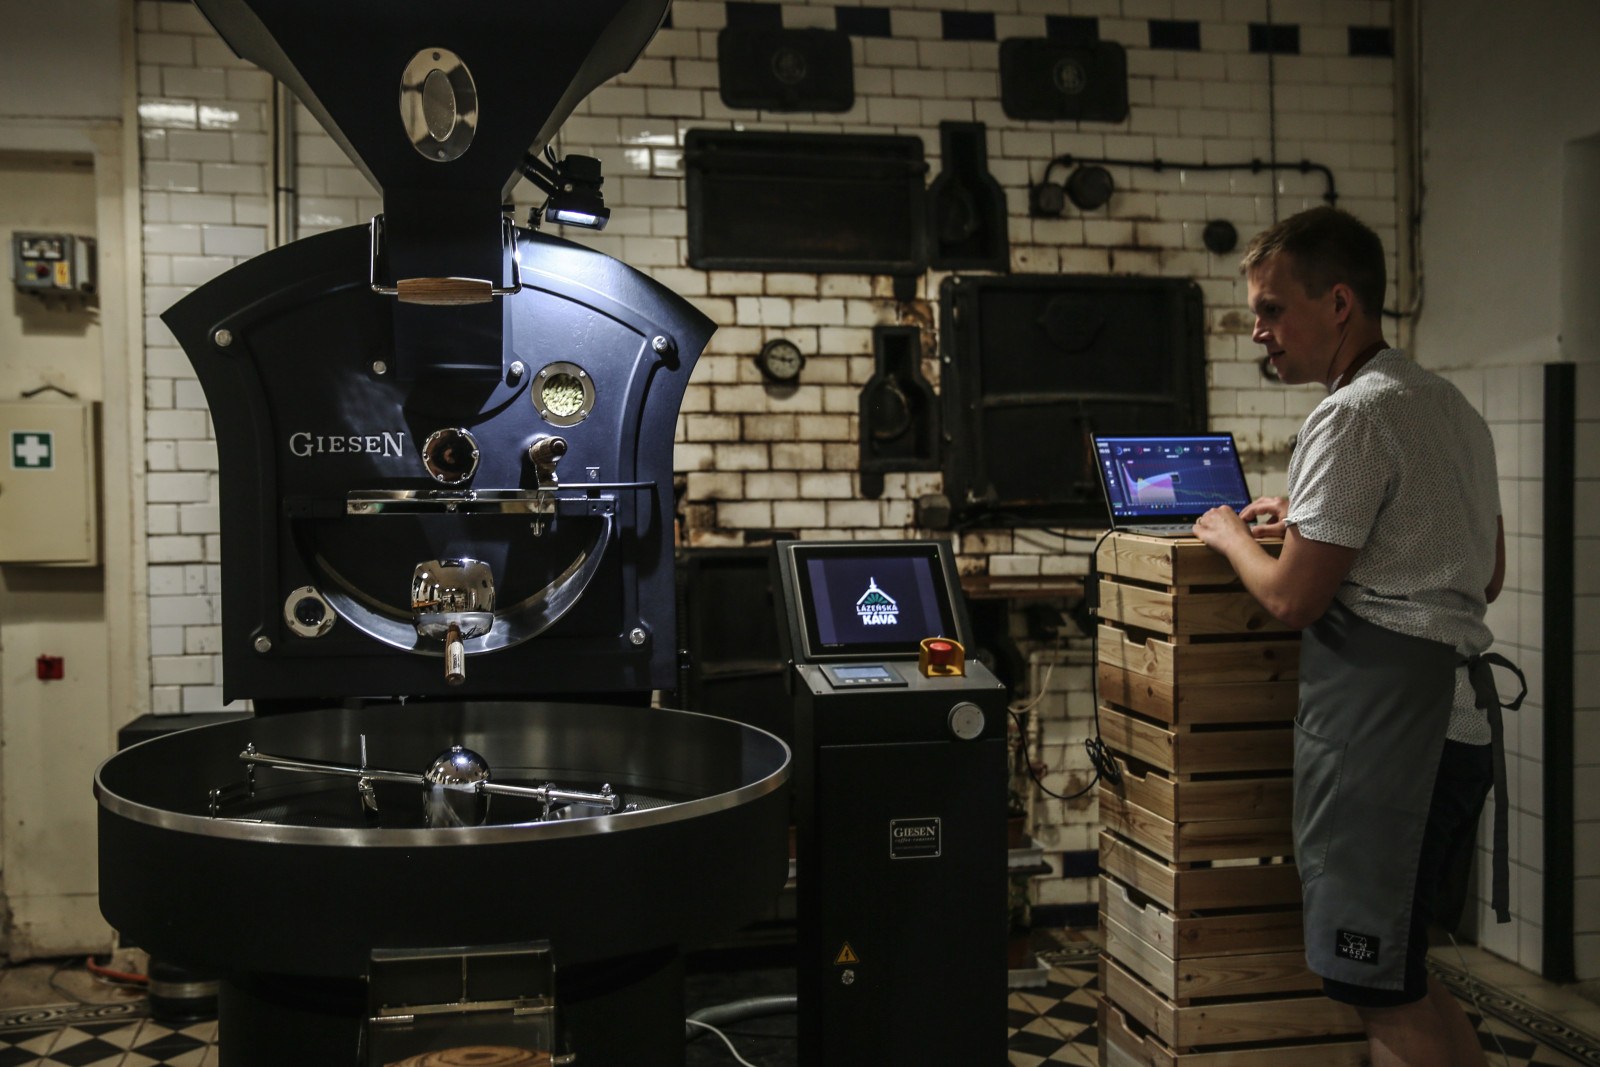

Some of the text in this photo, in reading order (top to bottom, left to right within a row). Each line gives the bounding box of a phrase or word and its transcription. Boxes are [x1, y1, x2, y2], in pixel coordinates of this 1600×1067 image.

[289, 432, 406, 457] GIESEN
[862, 611, 898, 625] KÁVA
[893, 826, 936, 838] GIESEN
